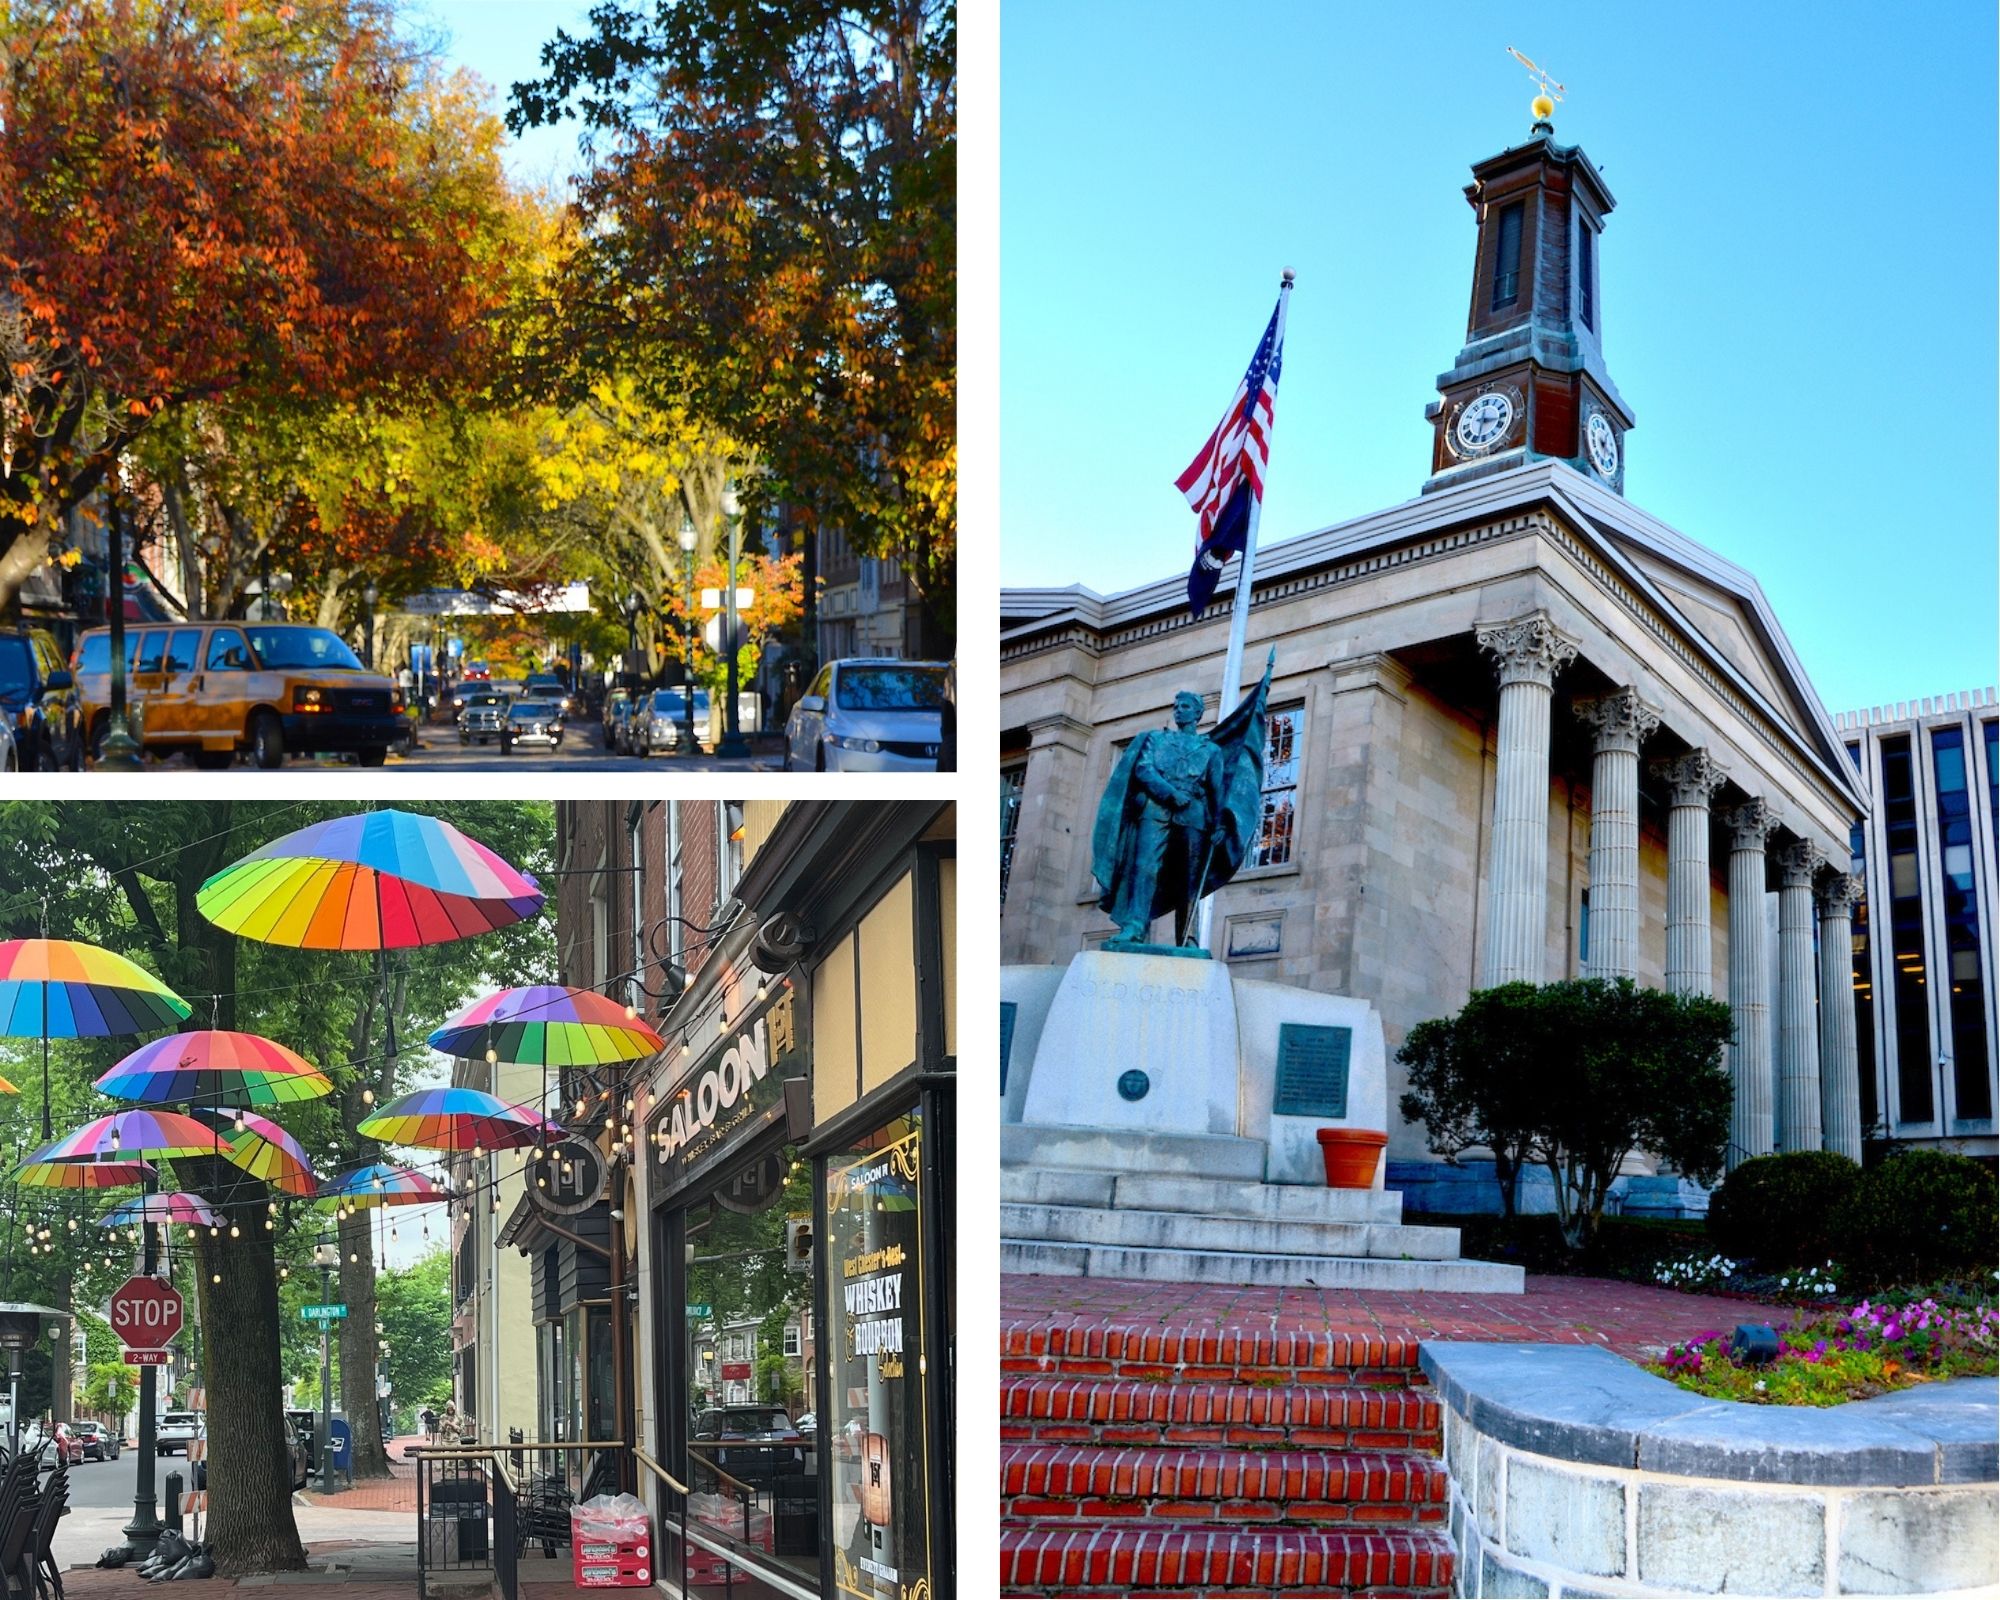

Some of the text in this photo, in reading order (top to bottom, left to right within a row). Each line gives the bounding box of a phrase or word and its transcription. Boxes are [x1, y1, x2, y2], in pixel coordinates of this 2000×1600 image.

[657, 1017, 767, 1165] SALOON
[851, 1166, 881, 1190] SALOON
[844, 1273, 903, 1314] WHISKEY
[115, 1299, 178, 1327] STOP
[855, 1317, 904, 1356] BOURBON
[132, 1353, 159, 1363] 2-WAY
